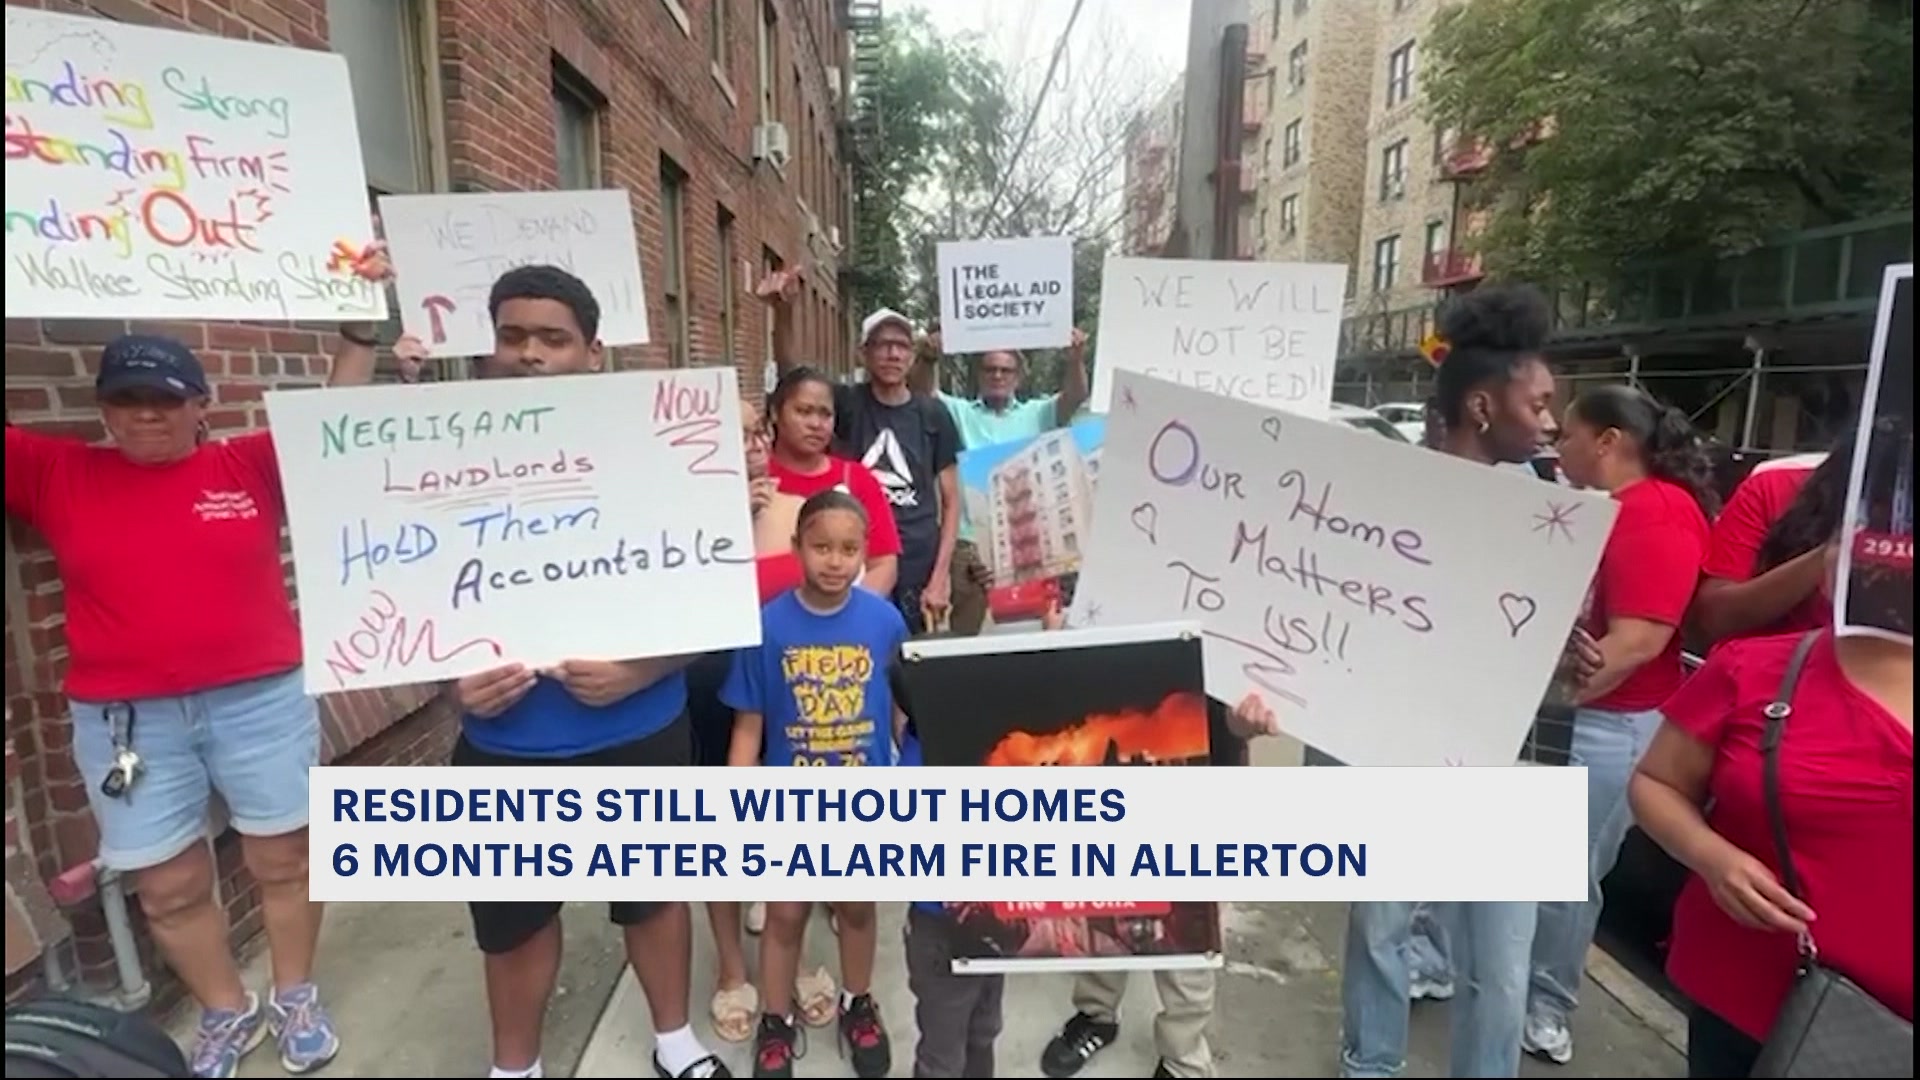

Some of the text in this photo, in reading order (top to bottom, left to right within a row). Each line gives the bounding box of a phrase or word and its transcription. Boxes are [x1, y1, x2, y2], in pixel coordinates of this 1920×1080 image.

[162, 67, 289, 139] Strong
[142, 190, 262, 252] Out
[427, 209, 473, 250] WE
[15, 247, 378, 316] Wallace Standing Strong
[962, 264, 999, 279] THE
[964, 280, 1061, 299] LEGAL AID
[964, 300, 1045, 319] SOCIETY
[1133, 276, 1332, 313] WE WILL
[1172, 324, 1309, 361] NOT BE
[321, 406, 555, 459] NEGLIGANT
[458, 503, 600, 548] Them
[1278, 468, 1433, 566] Home
[451, 529, 752, 609] Accountable
[800, 692, 860, 717] DAY
